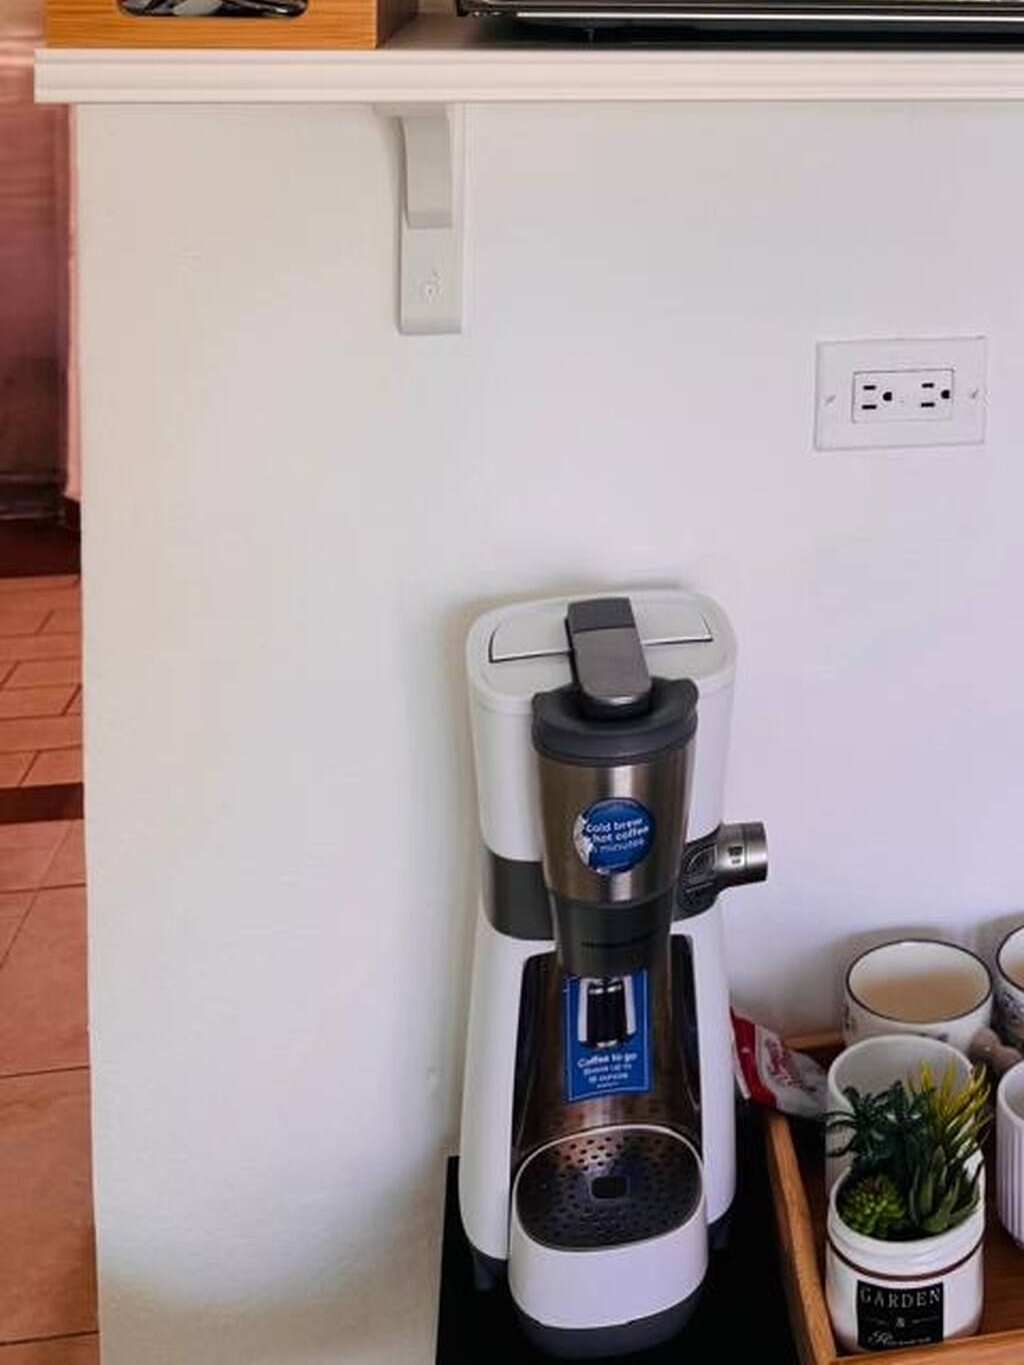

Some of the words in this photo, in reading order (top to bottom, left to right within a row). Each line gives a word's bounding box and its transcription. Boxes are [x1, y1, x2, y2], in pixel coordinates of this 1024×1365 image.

[586, 822, 612, 834] Cold
[613, 818, 643, 831] brew
[593, 833, 613, 843] hot
[615, 825, 649, 841] coffee
[577, 1055, 610, 1068] Coffee
[860, 1287, 940, 1309] GARDEN
